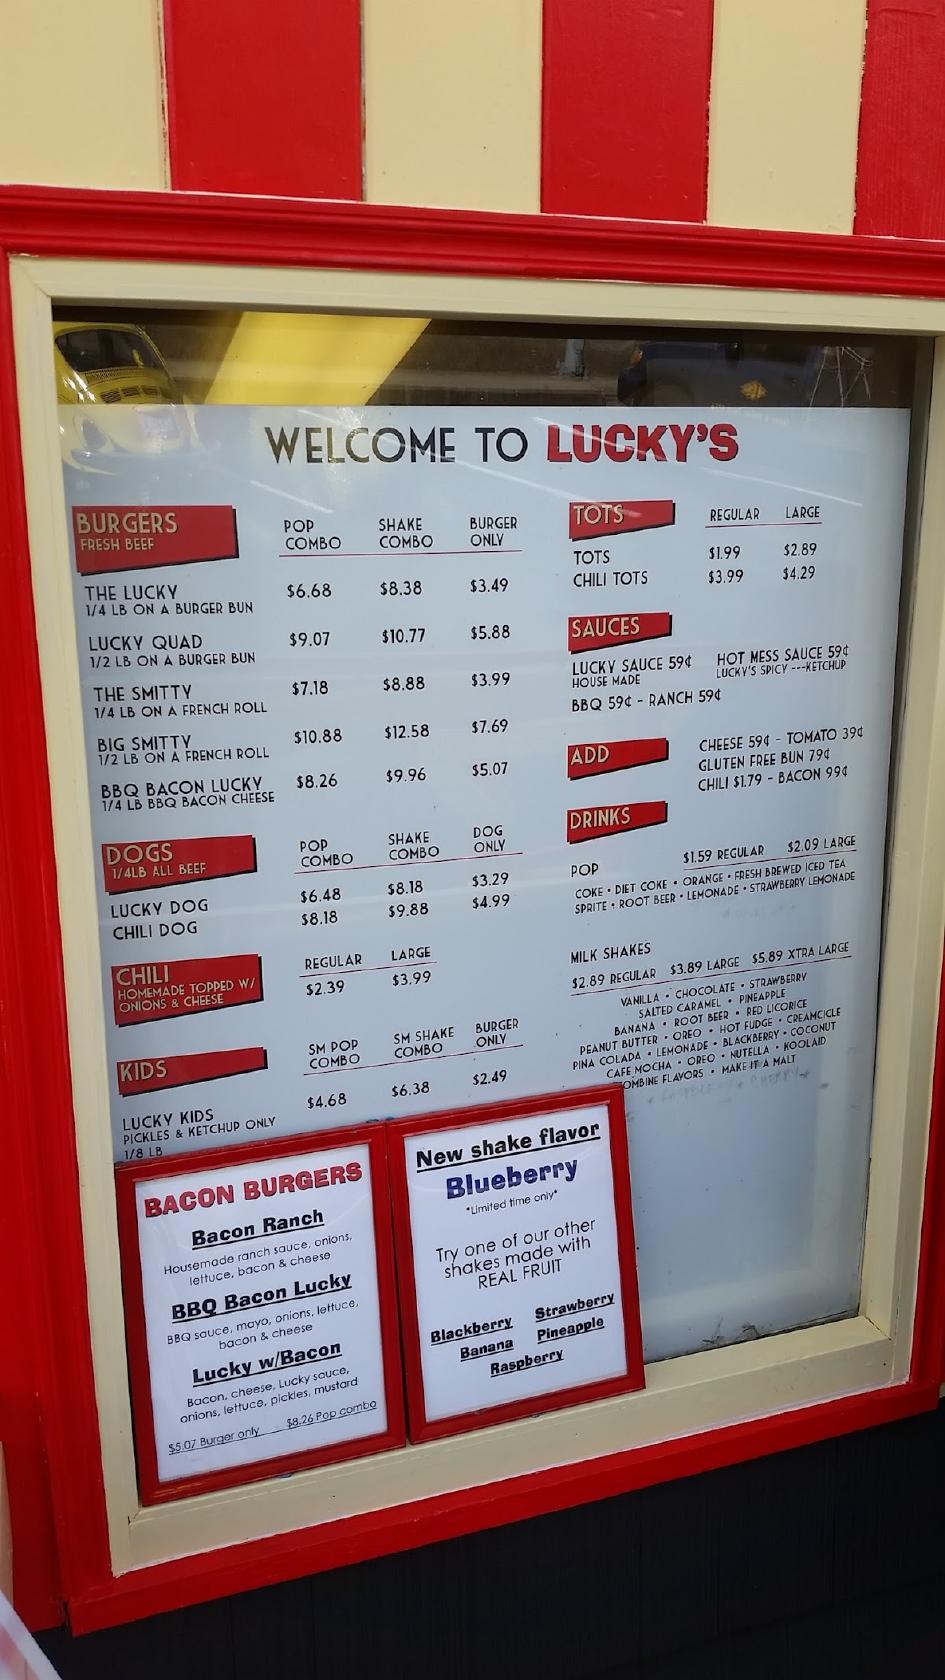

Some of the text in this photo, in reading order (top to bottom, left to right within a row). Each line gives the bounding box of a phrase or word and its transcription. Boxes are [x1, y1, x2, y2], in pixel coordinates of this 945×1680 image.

[265, 423, 739, 464] WELCOME TO LUCKY'S
[574, 504, 624, 525] TOTS
[711, 506, 819, 521] REGULAR LARGE
[77, 512, 178, 535] BURGERS
[284, 520, 313, 532] POP
[379, 518, 421, 531] SHAKE
[471, 516, 517, 529] BURGER
[81, 537, 156, 552] FRESH BEEF
[286, 537, 341, 550] COMBO
[380, 535, 433, 548] COMBO
[471, 534, 503, 546] ONLY
[574, 571, 647, 587] CHILI TOTS
[709, 569, 743, 583] $3.99
[783, 566, 815, 580] $4.29
[85, 585, 177, 601] THE LUCKY
[288, 584, 331, 598] $6.68
[381, 581, 421, 595] $8.38
[471, 578, 508, 592] $3.49
[86, 601, 253, 616] 1/4 LB ON A BURGER BUN
[383, 628, 425, 643] $10.77
[472, 625, 510, 639] $5.88
[572, 616, 639, 638] SAUCES
[89, 635, 202, 651] LUCKY QUAD
[290, 632, 329, 647] $9.07
[718, 645, 848, 666] HOT MESS SAUCE 59¢
[573, 655, 691, 675] LUCKY SAUCE 59¢
[717, 666, 756, 678] LUCKY'S
[761, 664, 787, 675] SPICY
[94, 685, 191, 701] THE SMITTY
[98, 735, 191, 752] BIG SMITTY
[700, 737, 743, 751] CHEESE
[749, 735, 769, 748] 59¢
[787, 729, 836, 744] TOMATO
[843, 726, 863, 739] 39¢
[571, 746, 609, 765] ADD
[699, 748, 829, 771] GLUTEN FREE BUN 79¢
[473, 762, 507, 776] $5.07
[102, 777, 261, 798] BBQ BACON LUCKY
[571, 807, 630, 829] DRINKS
[389, 832, 429, 845] SHAKE
[474, 825, 502, 838] DOG
[300, 839, 327, 852] POP
[788, 836, 855, 852] $2.09 LARGE
[107, 842, 172, 865] DOGS
[684, 845, 764, 863] $1.59 REGULAR
[113, 862, 205, 879] 1/4LB ALL BEEF
[388, 881, 423, 895] $8.18
[473, 872, 508, 887] $3.29
[301, 888, 340, 903] $6.48
[111, 899, 208, 918] LUCKY DOG
[113, 921, 197, 940] CHILI DOG
[392, 947, 430, 961] LARGE
[571, 943, 650, 963] MILK SHAKES
[305, 954, 362, 970] REGULAR
[117, 965, 168, 985] CHILI
[393, 971, 431, 986] $3.99
[118, 978, 255, 1000] HOMEMADE TOPPED W/
[621, 973, 807, 1006] VANILLA CHOCOLATE STRAWBERRY
[120, 993, 223, 1012] ONIONS & CHEESE
[580, 1008, 840, 1055] PEANUT BUTTER OREO HOT FUDGE CREAMCICLE
[309, 1040, 358, 1055] SM POP
[121, 1060, 167, 1082] KIDS
[473, 1070, 506, 1085] $2.49
[612, 1076, 658, 1088] OMBINE
[663, 1069, 703, 1083] FLAVORS
[722, 1062, 746, 1074] MAKE
[751, 1059, 758, 1069] IT
[773, 1055, 795, 1066] MALT
[392, 1081, 429, 1097] $6.38
[308, 1093, 346, 1109] $4.68
[123, 1109, 213, 1131] LUCKY KIDS
[124, 1117, 275, 1144] PICKLES & KETCHUP ONLY
[125, 1148, 163, 1159] 1/8 LB
[416, 1124, 599, 1166] New shake flavor
[447, 1160, 577, 1200] Blueberry
[144, 1162, 362, 1218] BACON BURGERS
[510, 1197, 530, 1207] time
[192, 1210, 323, 1246] Bacon Ranch
[164, 1234, 352, 1275] Housemade ranch sauce, onions,
[479, 1259, 562, 1288] REAL FRUIT
[173, 1274, 352, 1324] BBQ Bacon Lucky
[535, 1293, 615, 1323] Strawberry
[431, 1318, 513, 1344] Blackberry
[538, 1317, 605, 1344] Pineapple
[461, 1340, 514, 1362] Banana
[193, 1340, 340, 1387] Lucky w/Bacon
[491, 1350, 564, 1377] Raspberry
[287, 1401, 377, 1430] $8.26 Pop combo
[168, 1427, 259, 1455] $5.07 Burger only
